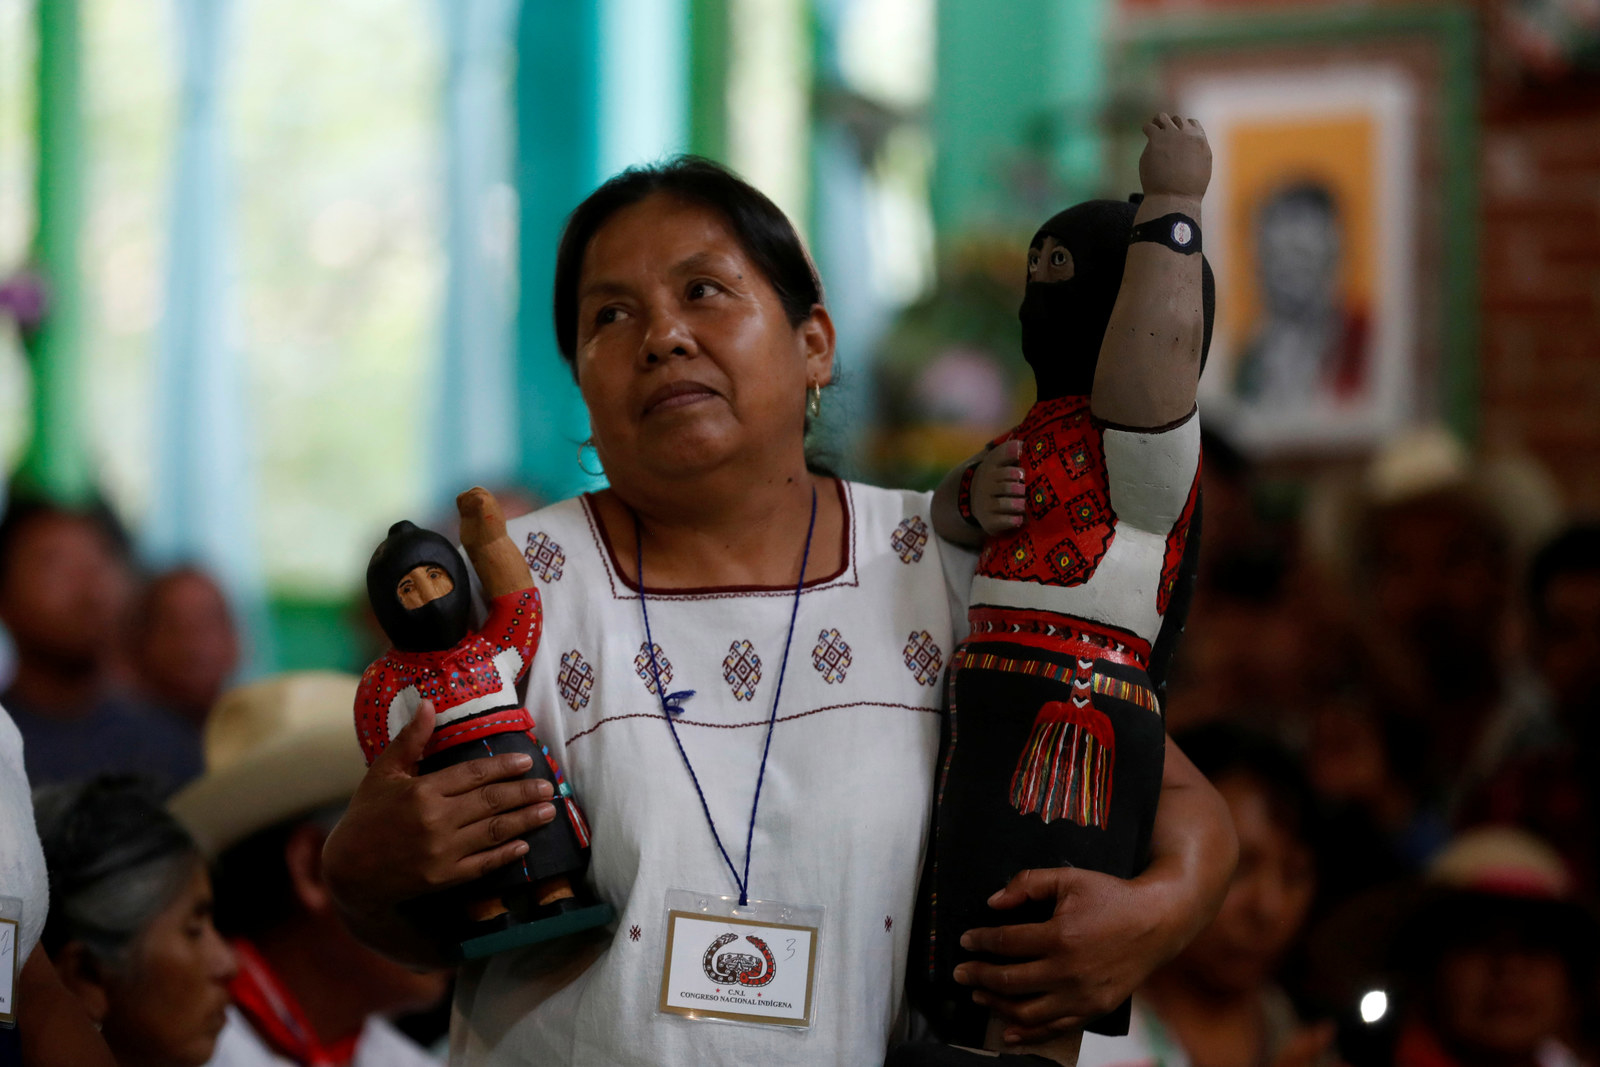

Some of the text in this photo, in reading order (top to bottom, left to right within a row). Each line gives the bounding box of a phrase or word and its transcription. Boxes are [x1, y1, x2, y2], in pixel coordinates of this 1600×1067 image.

[785, 938, 796, 961] 3
[680, 991, 792, 1008] CONGRESO NACIONAL INDÍGENA
